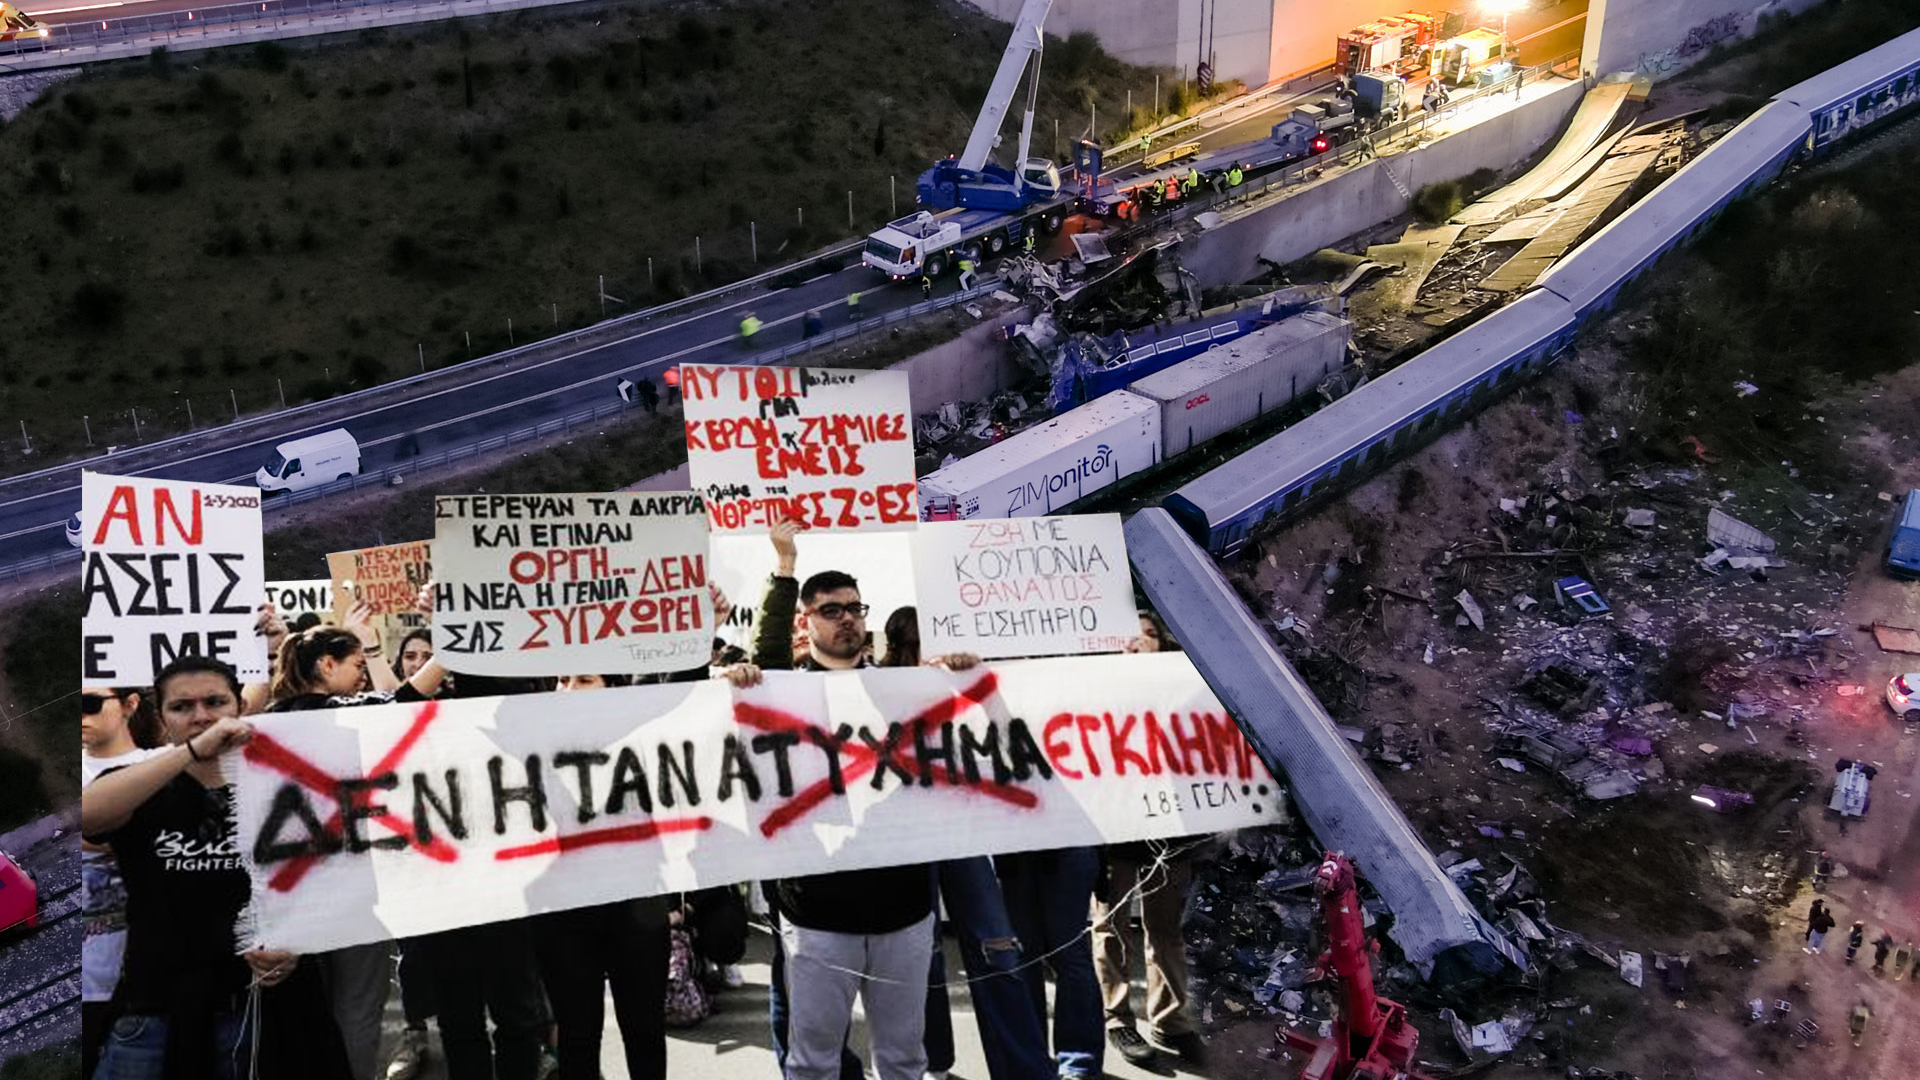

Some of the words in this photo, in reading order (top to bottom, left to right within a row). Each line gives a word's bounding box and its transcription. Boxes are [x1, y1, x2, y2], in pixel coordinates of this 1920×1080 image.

[682, 366, 800, 401] ΑΥΤΟΙ
[685, 416, 780, 452] ΚΕΡΔΗ
[798, 413, 907, 446] ΖΗΜΙΕΣ
[756, 444, 865, 479] ΕΜΕΙΣ
[1008, 449, 1113, 513] ZIMonitor
[92, 485, 202, 546] ΑΝ
[435, 496, 574, 519] ΣΤΕΡΕΨΑΝ
[587, 498, 620, 516] ΤΑ
[629, 495, 706, 516] ΔΑΚΡΥΑ
[830, 483, 917, 527] ΖΩΕΣ
[966, 504, 980, 516] ZIM
[472, 524, 520, 547] ΚΑΙ
[530, 523, 632, 547] ΕΓΙΝΑΝ
[965, 522, 1025, 549] ΖΩΗ
[1032, 519, 1068, 541] ΜΕ
[639, 553, 706, 596] ΔΕΝ
[953, 544, 1110, 582] ΚΟΥΠΟΝΙΑ
[435, 582, 454, 612] Η
[463, 583, 526, 611] ΝΕΑ
[536, 583, 551, 607] Η
[563, 577, 629, 605] ΓΕΝΙΑ
[959, 574, 1102, 608] ΘΑΝΑΤΟΣ
[519, 594, 702, 650] ΣΥΓΧΩΡΕΙ
[932, 613, 964, 638] ΜΕ
[975, 605, 1098, 638] ΕΙΣΗΤΗΡΙΟ
[254, 768, 469, 864] ΔΕΝ
[718, 715, 1053, 802] ΑΤΥΧΗΜΑ
[1191, 782, 1237, 810] ΓΕΛ
